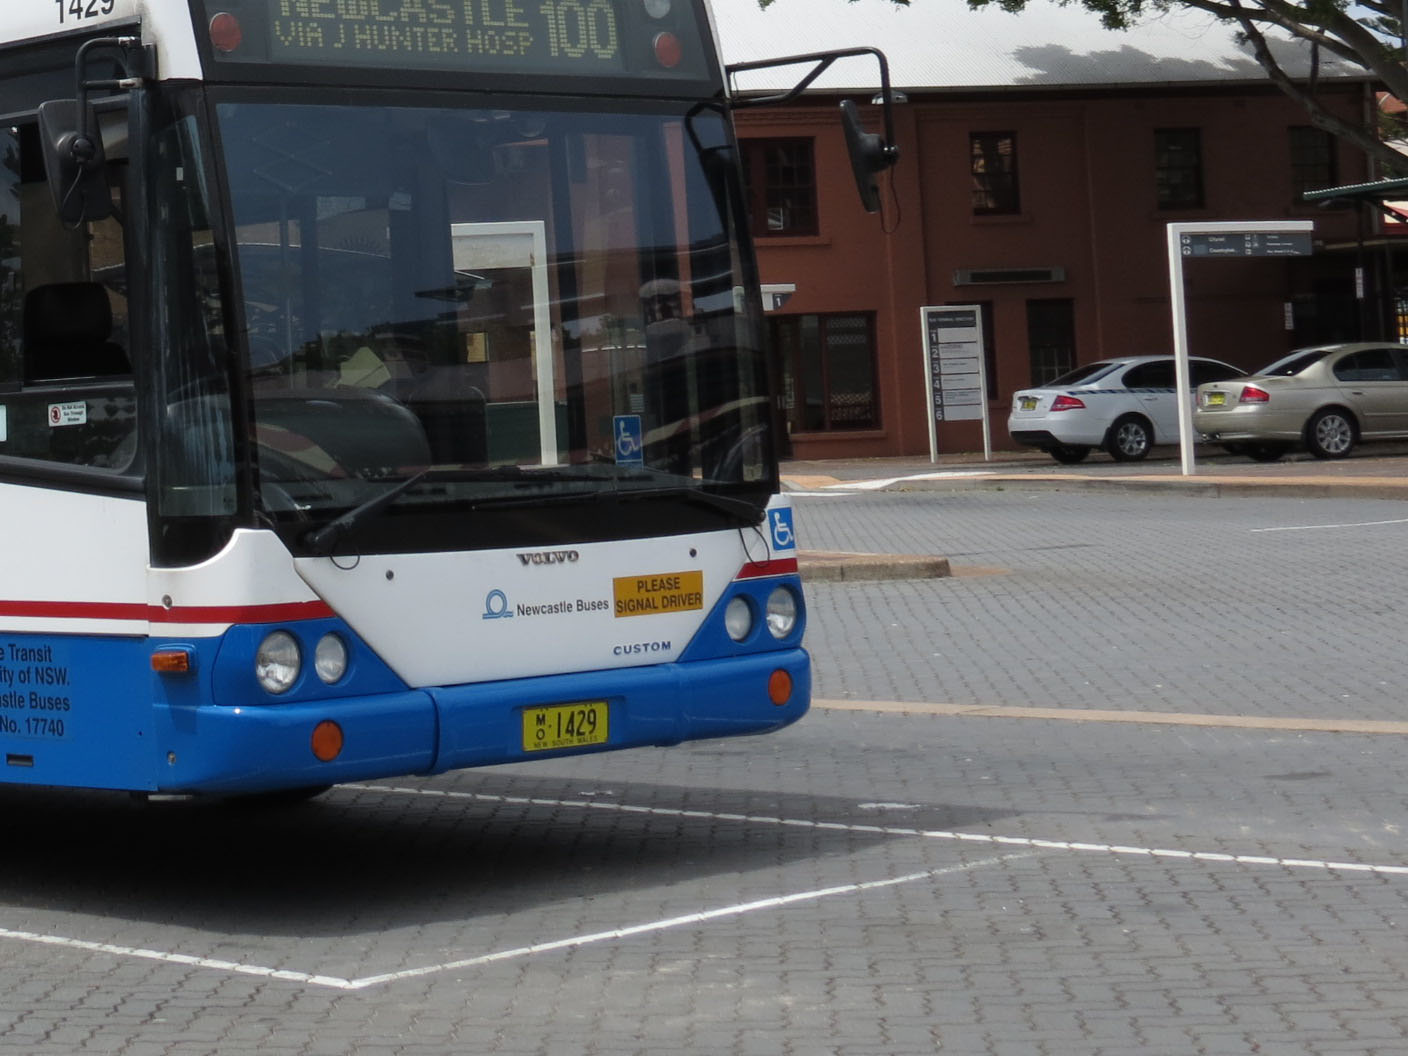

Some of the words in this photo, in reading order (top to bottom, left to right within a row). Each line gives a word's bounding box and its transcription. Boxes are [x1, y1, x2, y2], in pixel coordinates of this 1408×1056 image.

[275, 20, 323, 48] VIA
[334, 23, 346, 48] J
[354, 23, 459, 53] HUNTER
[467, 29, 534, 55] HOSP
[776, 297, 781, 307] 1
[932, 348, 939, 358] 2
[933, 363, 940, 374] 3
[934, 379, 940, 389] 4
[936, 410, 943, 420] 6
[516, 550, 579, 566] VOLVO
[637, 577, 680, 592] PLEASE
[517, 599, 573, 616] Newcastle
[576, 598, 609, 612] Buses
[616, 595, 659, 613] SIGNAL
[662, 592, 702, 608] DRIVER
[8, 644, 52, 662] Transit
[613, 641, 671, 655] CUSTOM
[18, 669, 30, 684] of
[35, 667, 70, 686] NSW.
[29, 691, 71, 711] Buses
[0, 715, 21, 733] No.
[25, 717, 65, 736] 17740
[557, 708, 598, 738] 1429
